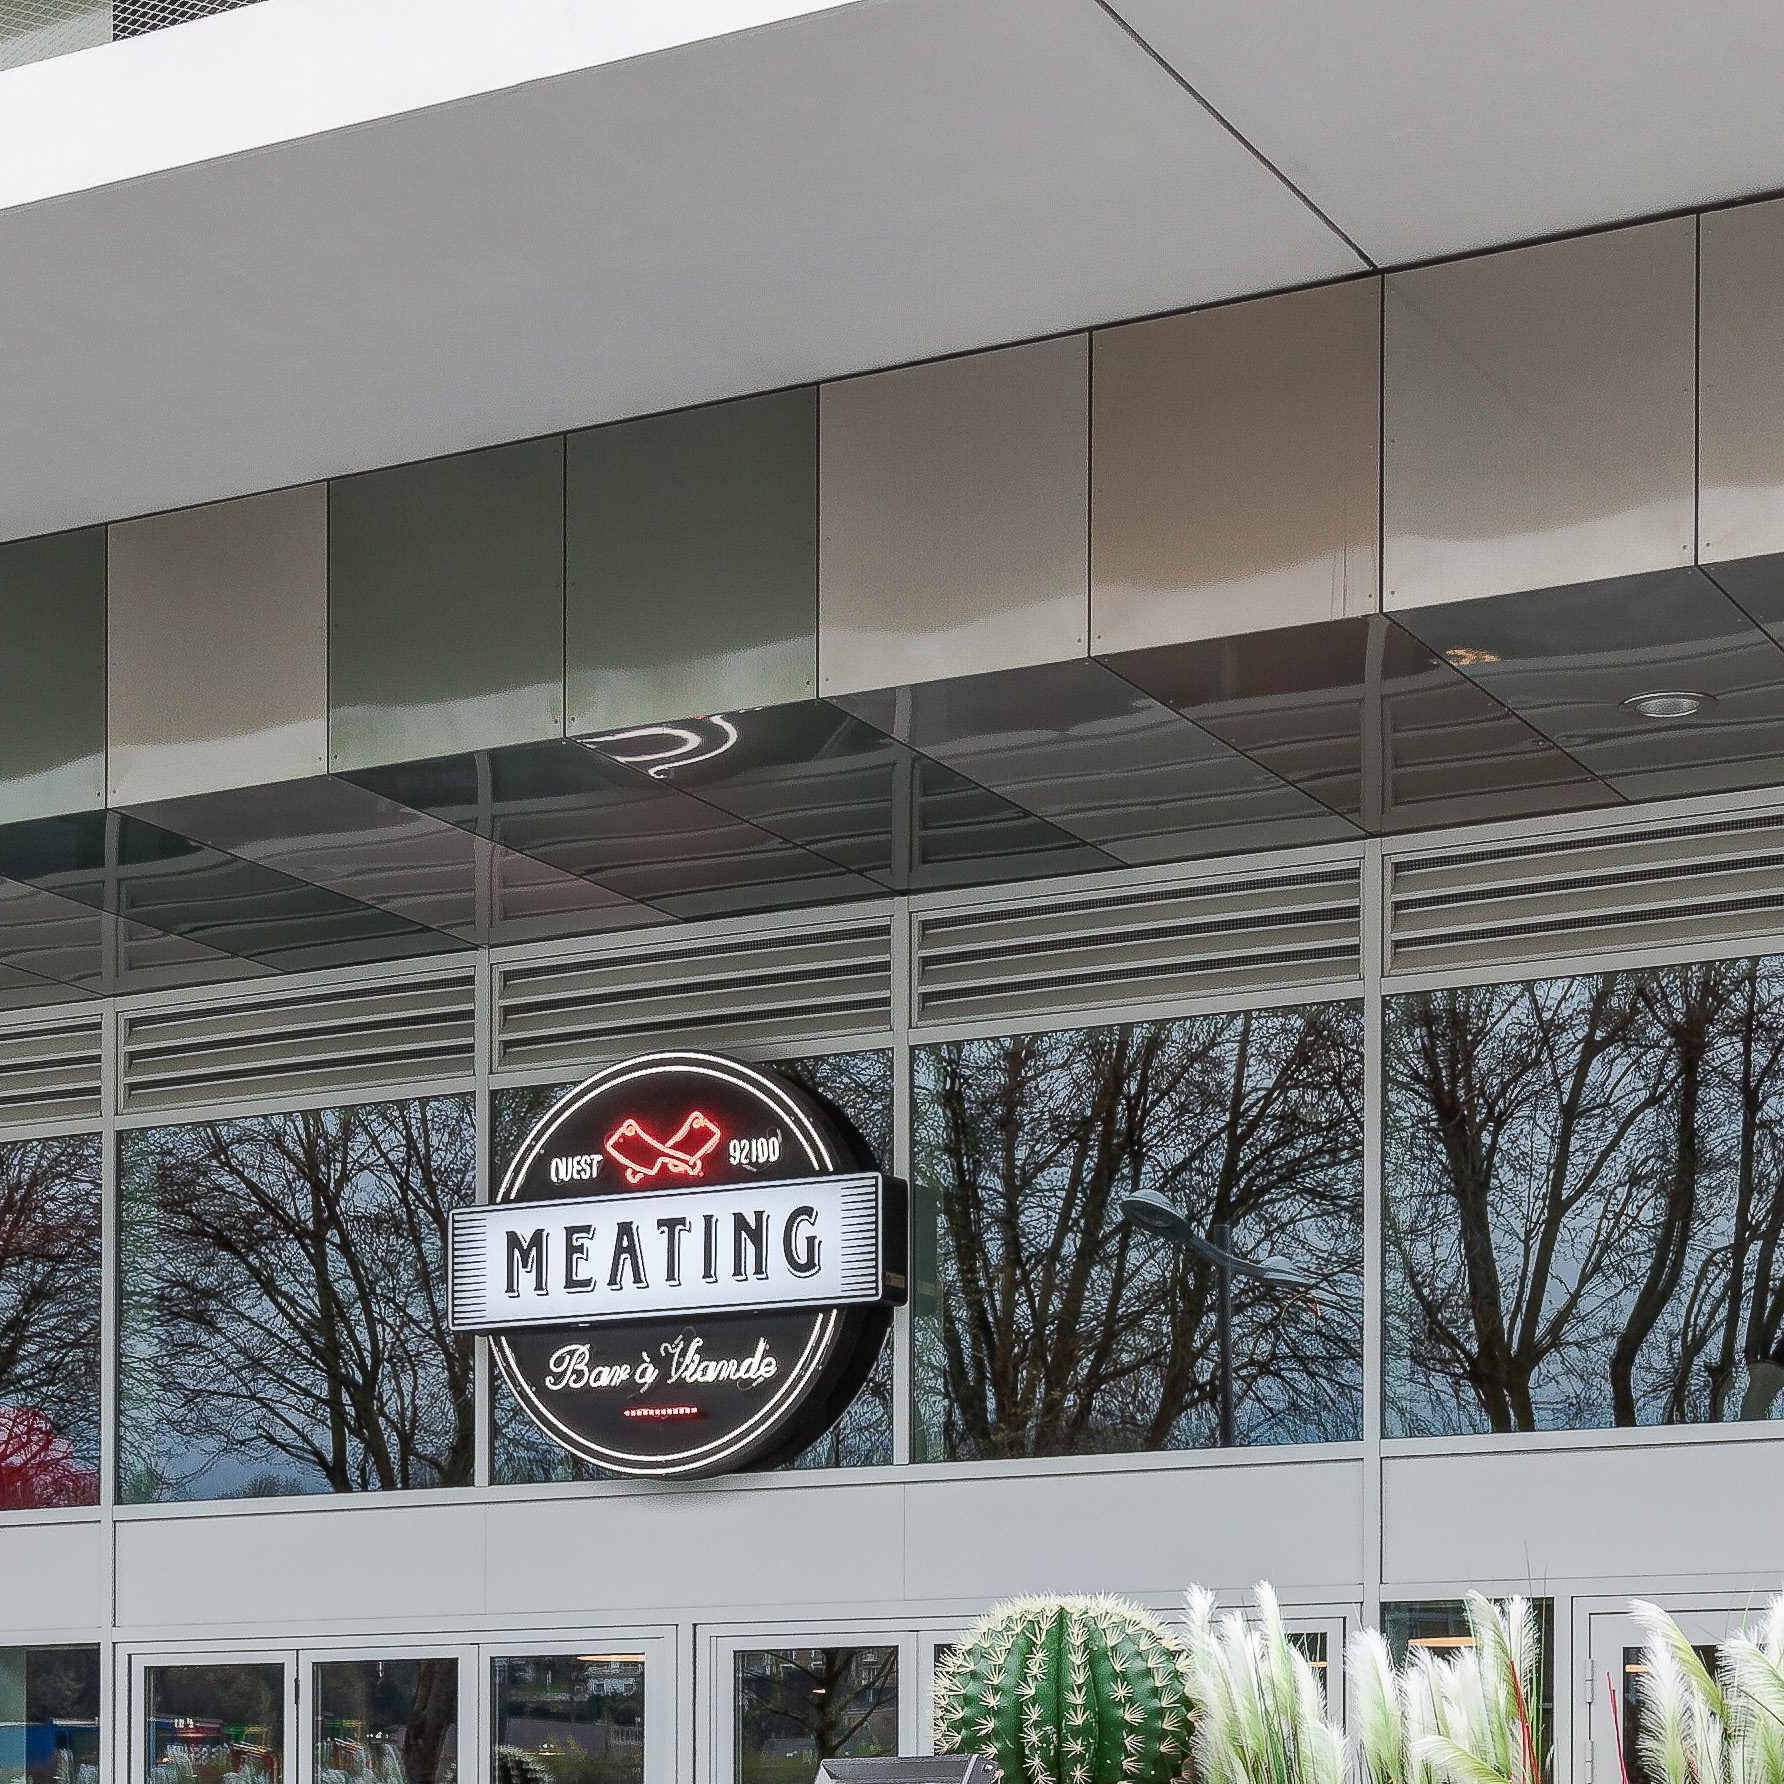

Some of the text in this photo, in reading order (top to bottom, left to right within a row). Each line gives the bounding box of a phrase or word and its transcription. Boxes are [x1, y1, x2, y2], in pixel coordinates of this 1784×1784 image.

[550, 1136, 781, 1182] OUEST 92100
[505, 1205, 822, 1298] MEATING
[545, 1335, 778, 1390] Bar à Viande
